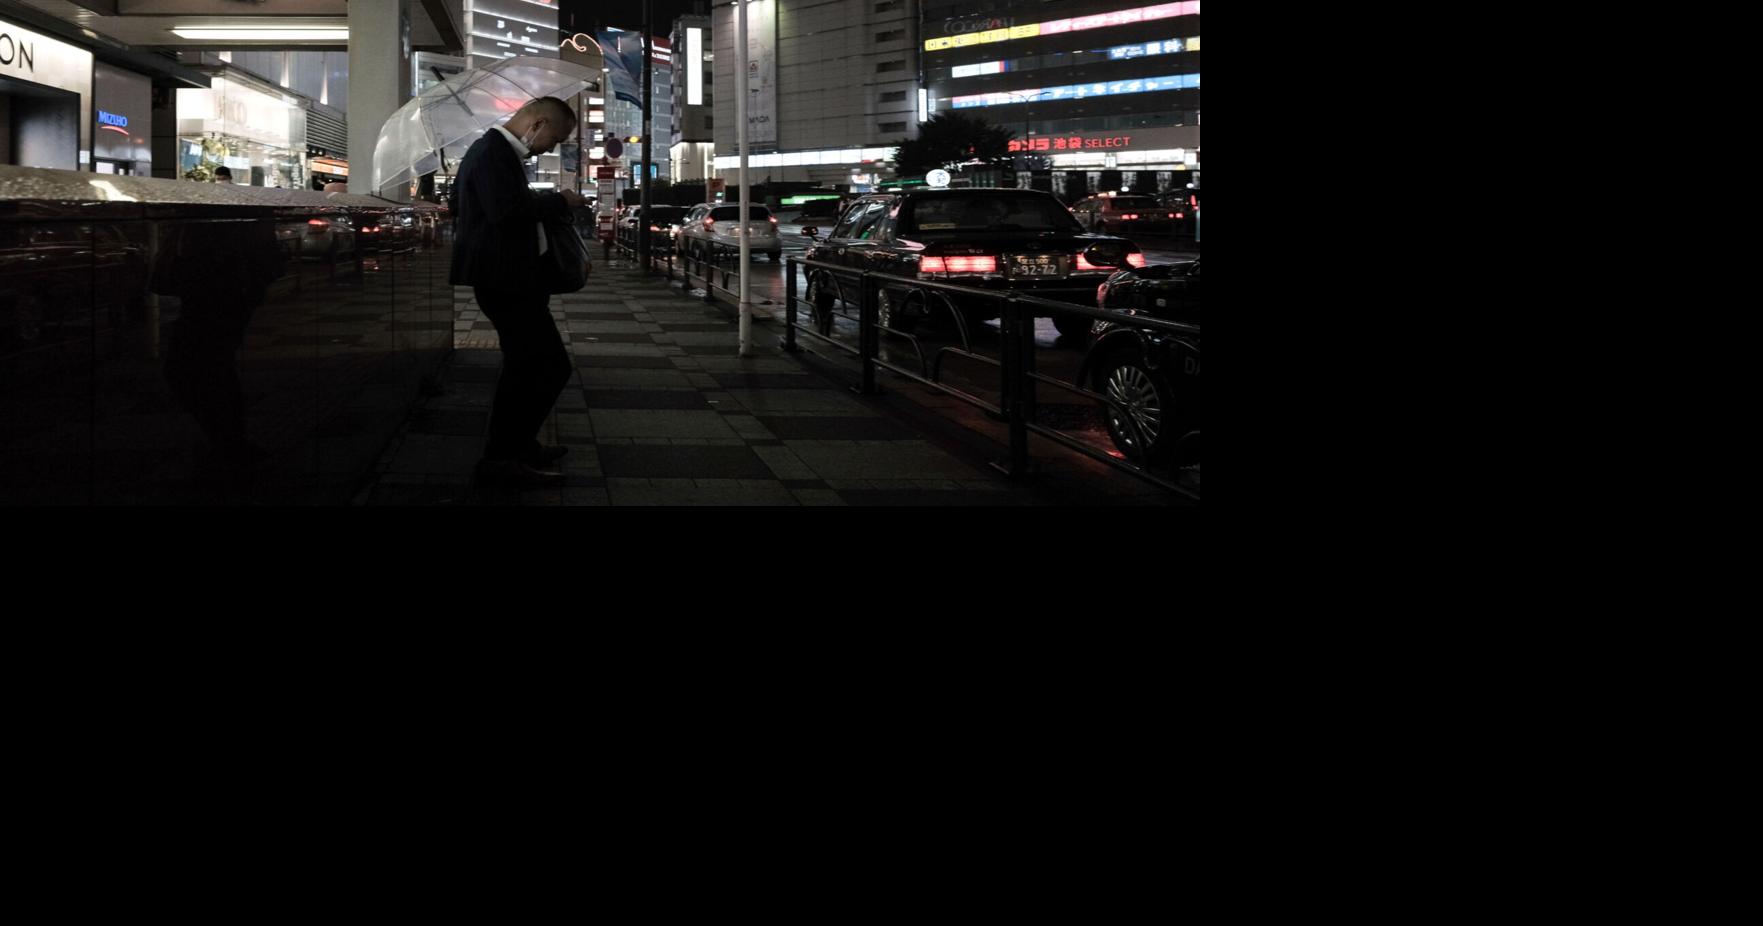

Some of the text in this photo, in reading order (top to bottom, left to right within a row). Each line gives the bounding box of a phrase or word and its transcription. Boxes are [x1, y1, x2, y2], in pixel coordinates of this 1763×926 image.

[98, 110, 128, 127] MIZUHO
[1054, 136, 1082, 150] 池袋
[1084, 136, 1131, 149] SELECT
